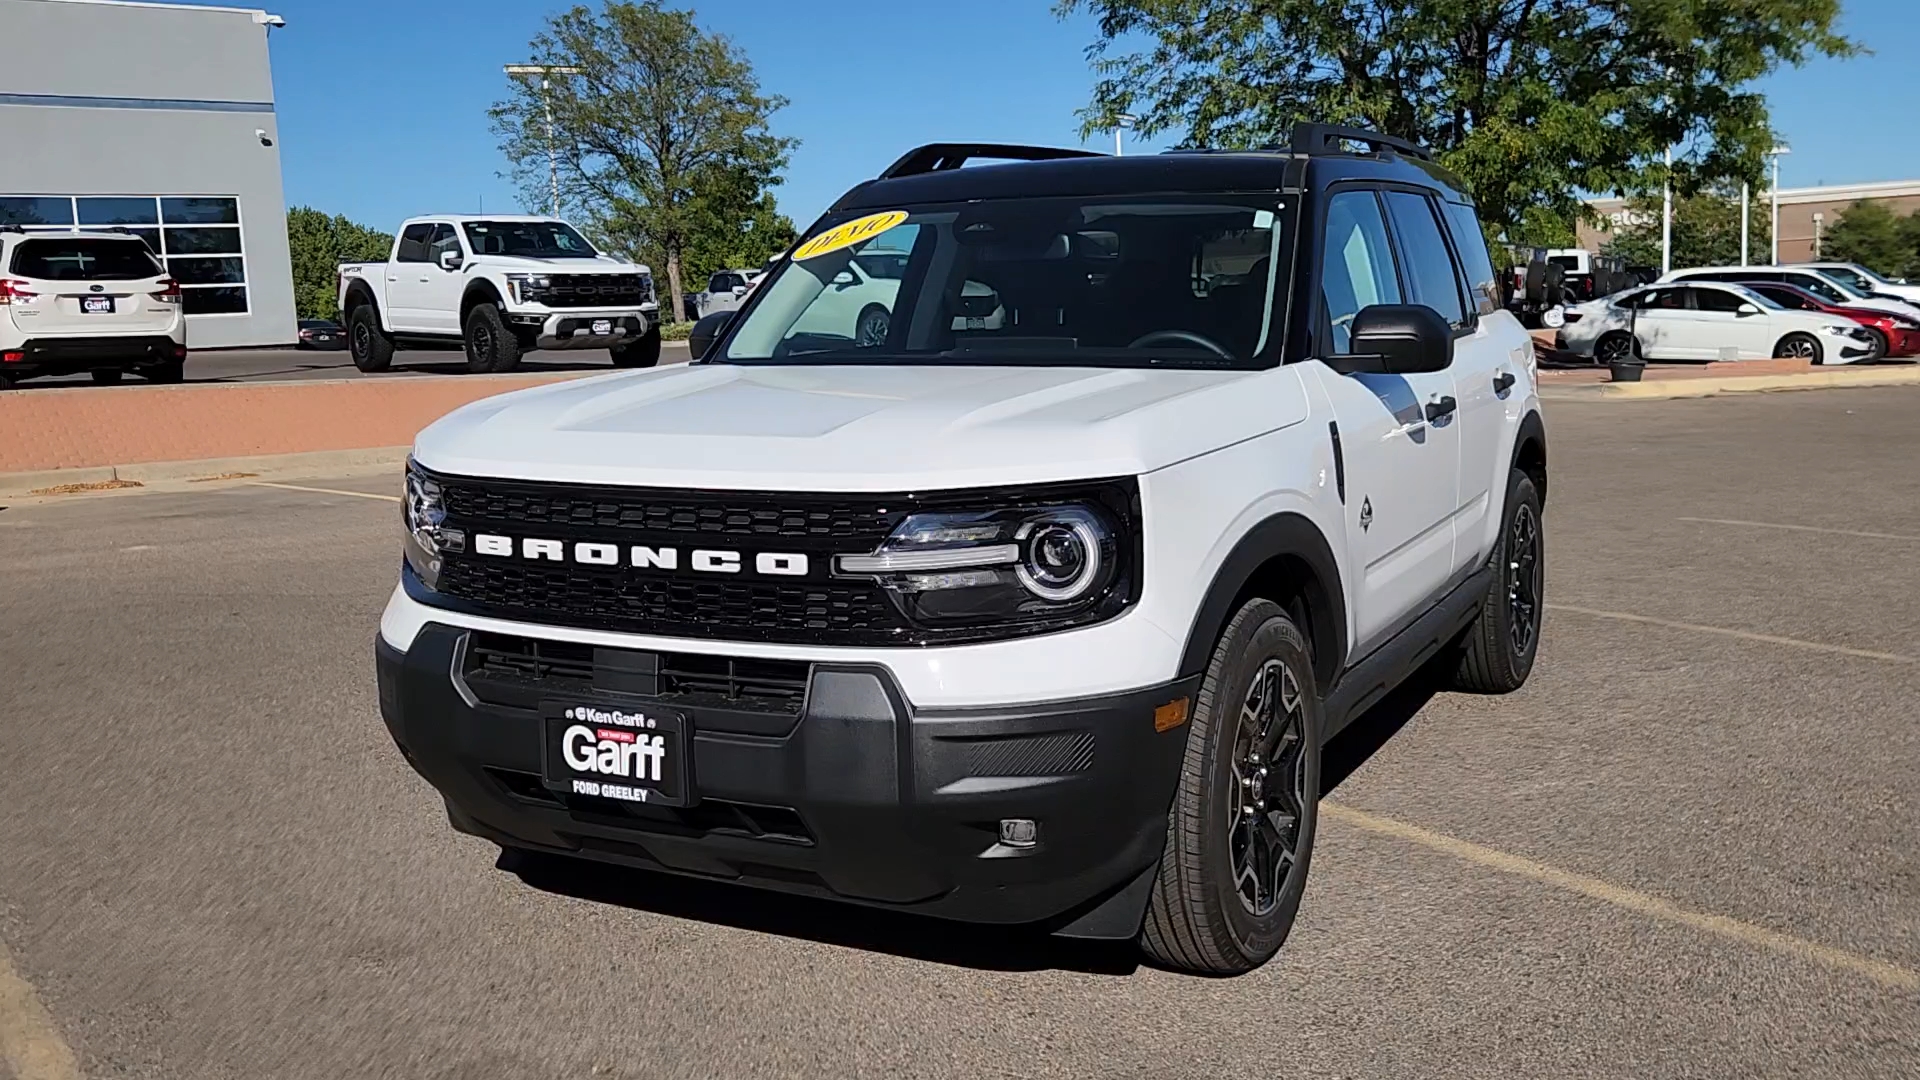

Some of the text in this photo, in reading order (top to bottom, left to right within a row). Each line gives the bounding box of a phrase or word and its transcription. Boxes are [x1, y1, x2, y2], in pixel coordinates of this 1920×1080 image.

[803, 215, 896, 256] DEMO
[1597, 208, 1658, 231] etc
[551, 286, 640, 295] FORD
[475, 534, 808, 575] BRONCO
[563, 725, 665, 781] Garff
[572, 780, 648, 802] FORD GREELEY
